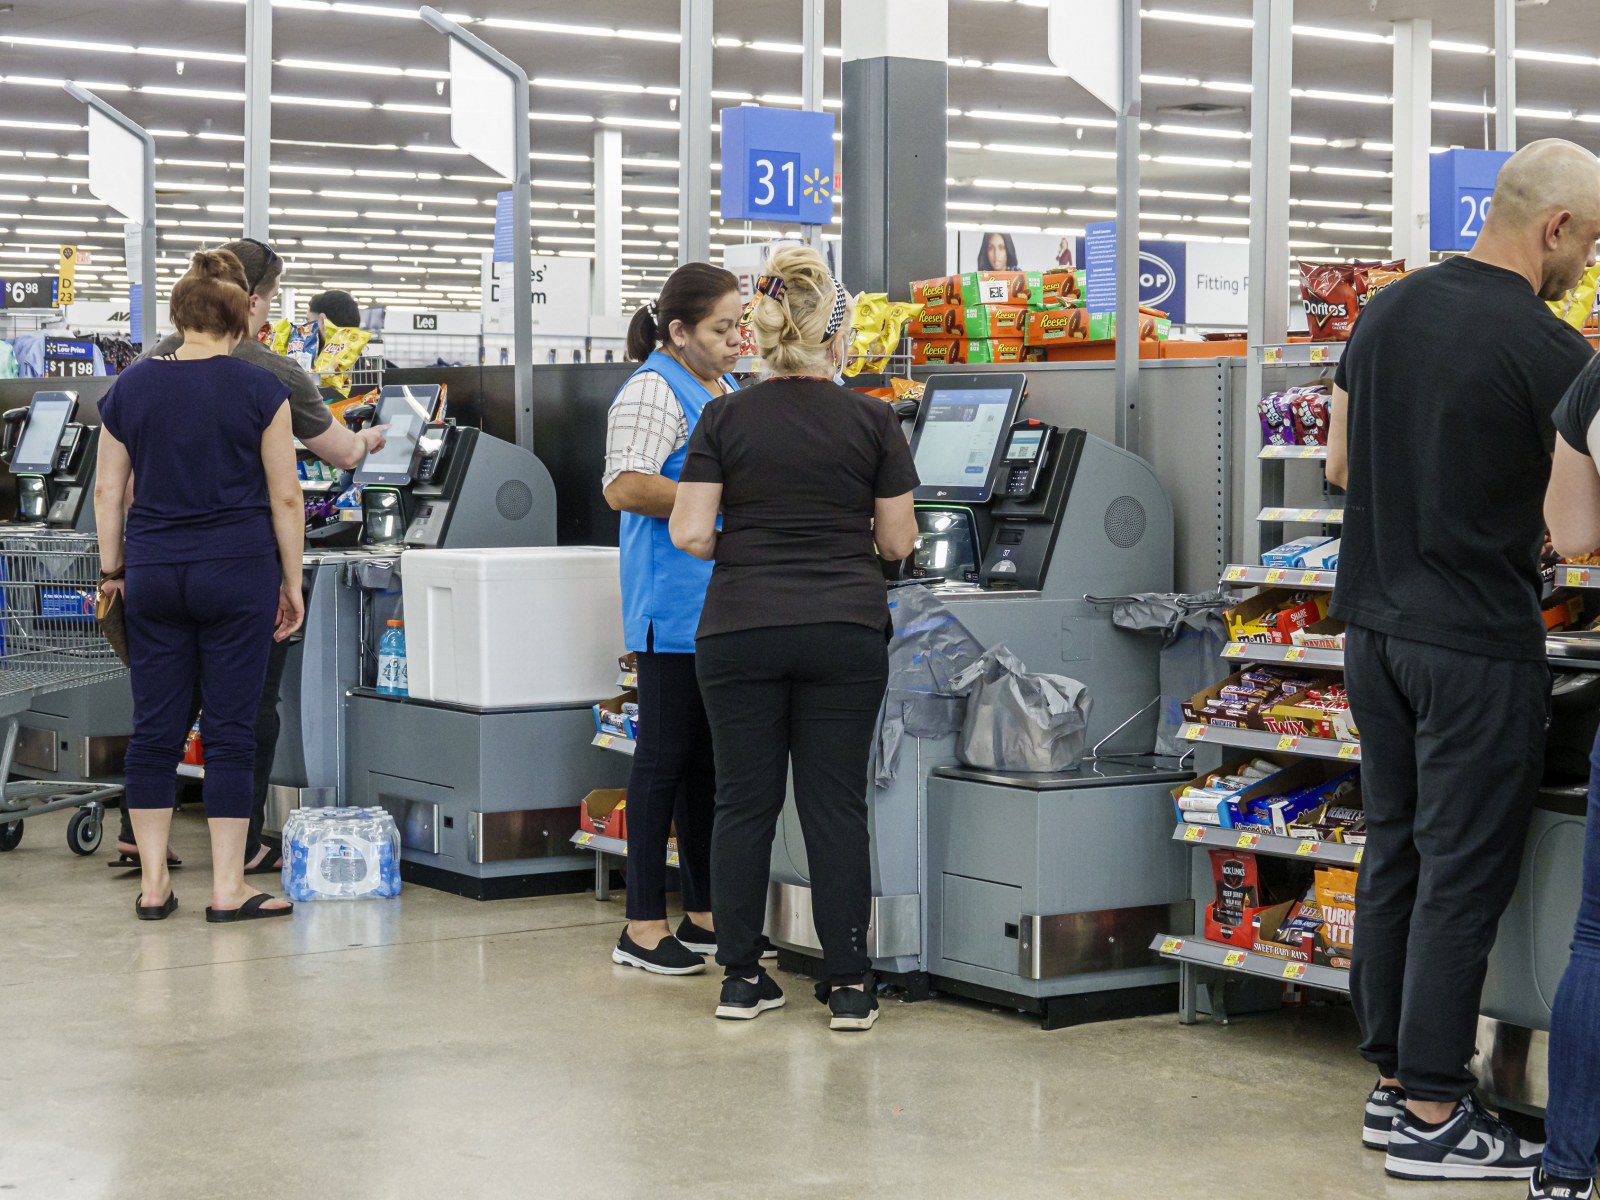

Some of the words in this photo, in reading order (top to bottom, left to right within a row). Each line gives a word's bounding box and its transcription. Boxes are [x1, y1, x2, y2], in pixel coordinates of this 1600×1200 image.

[754, 159, 795, 206] 31
[62, 278, 72, 288] D
[1043, 282, 1060, 290] eese's
[1197, 274, 1239, 295] Fitting
[922, 283, 945, 297] Reese's
[60, 292, 72, 302] 23
[1303, 300, 1347, 316] Doritos
[919, 310, 943, 323] Reese's
[995, 310, 1016, 319] Reese's
[416, 315, 435, 328] Lee
[1040, 314, 1067, 328] Reese's
[57, 345, 70, 353] Low
[70, 346, 86, 354] Price
[923, 343, 948, 355] Reese's
[997, 343, 1018, 353] Reese's
[1003, 549, 1010, 557] 37
[1291, 609, 1308, 622] SHARE
[1321, 904, 1355, 926] TURK
[1253, 943, 1273, 954] SWEET
[1274, 946, 1289, 957] BABY
[1291, 949, 1308, 961] RAY'S
[1372, 1091, 1389, 1101] NIKE
[1551, 1187, 1570, 1198] NIKE
